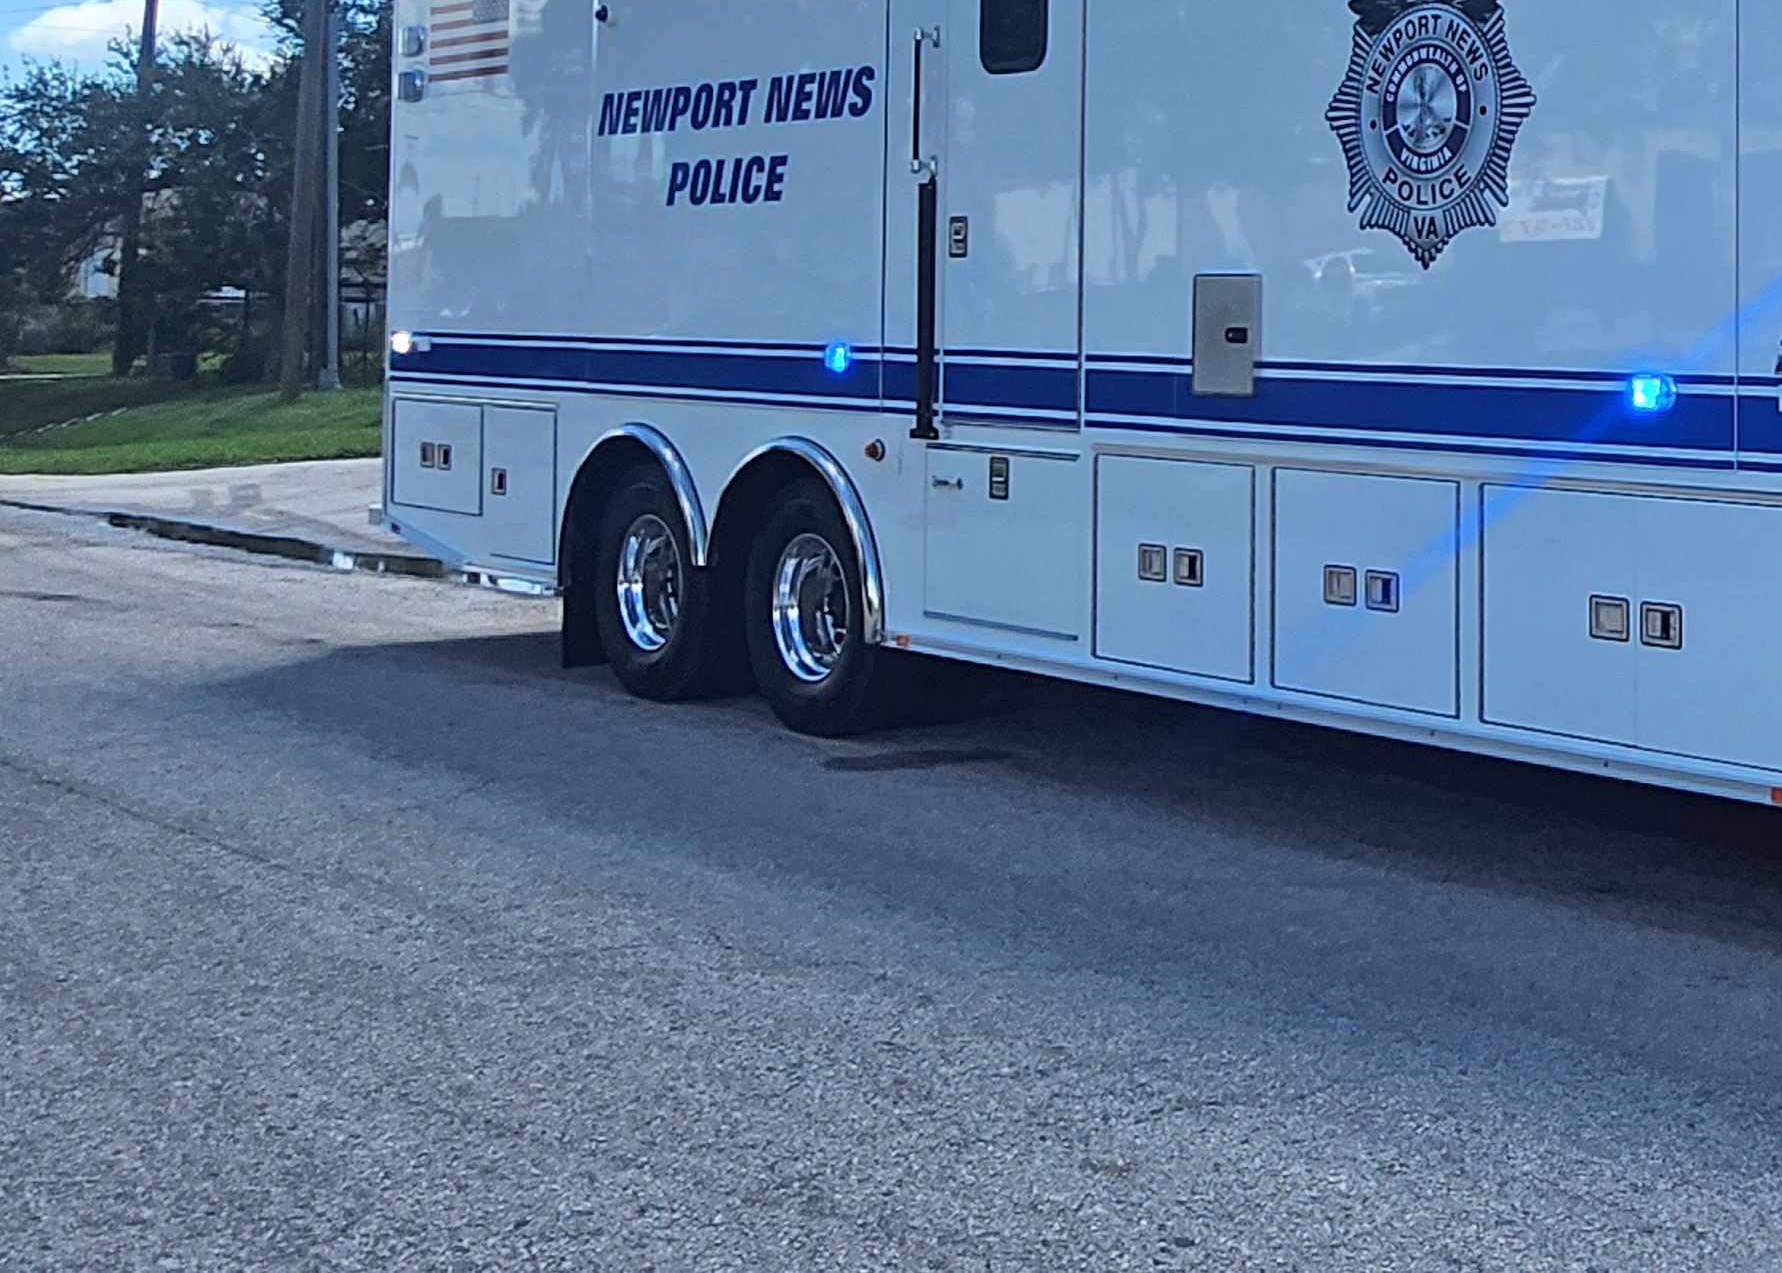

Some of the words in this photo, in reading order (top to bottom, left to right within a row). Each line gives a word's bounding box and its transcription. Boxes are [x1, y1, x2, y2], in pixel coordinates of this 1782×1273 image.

[1366, 14, 1441, 94] NEWPORT
[1444, 18, 1488, 81] NEWS
[598, 79, 758, 136] NEWPORT
[764, 66, 876, 123] NEWS
[666, 155, 788, 207] POLICE
[1400, 147, 1453, 171] VIRGINIA
[1382, 164, 1471, 205] POLICE
[1413, 215, 1439, 239] VA
